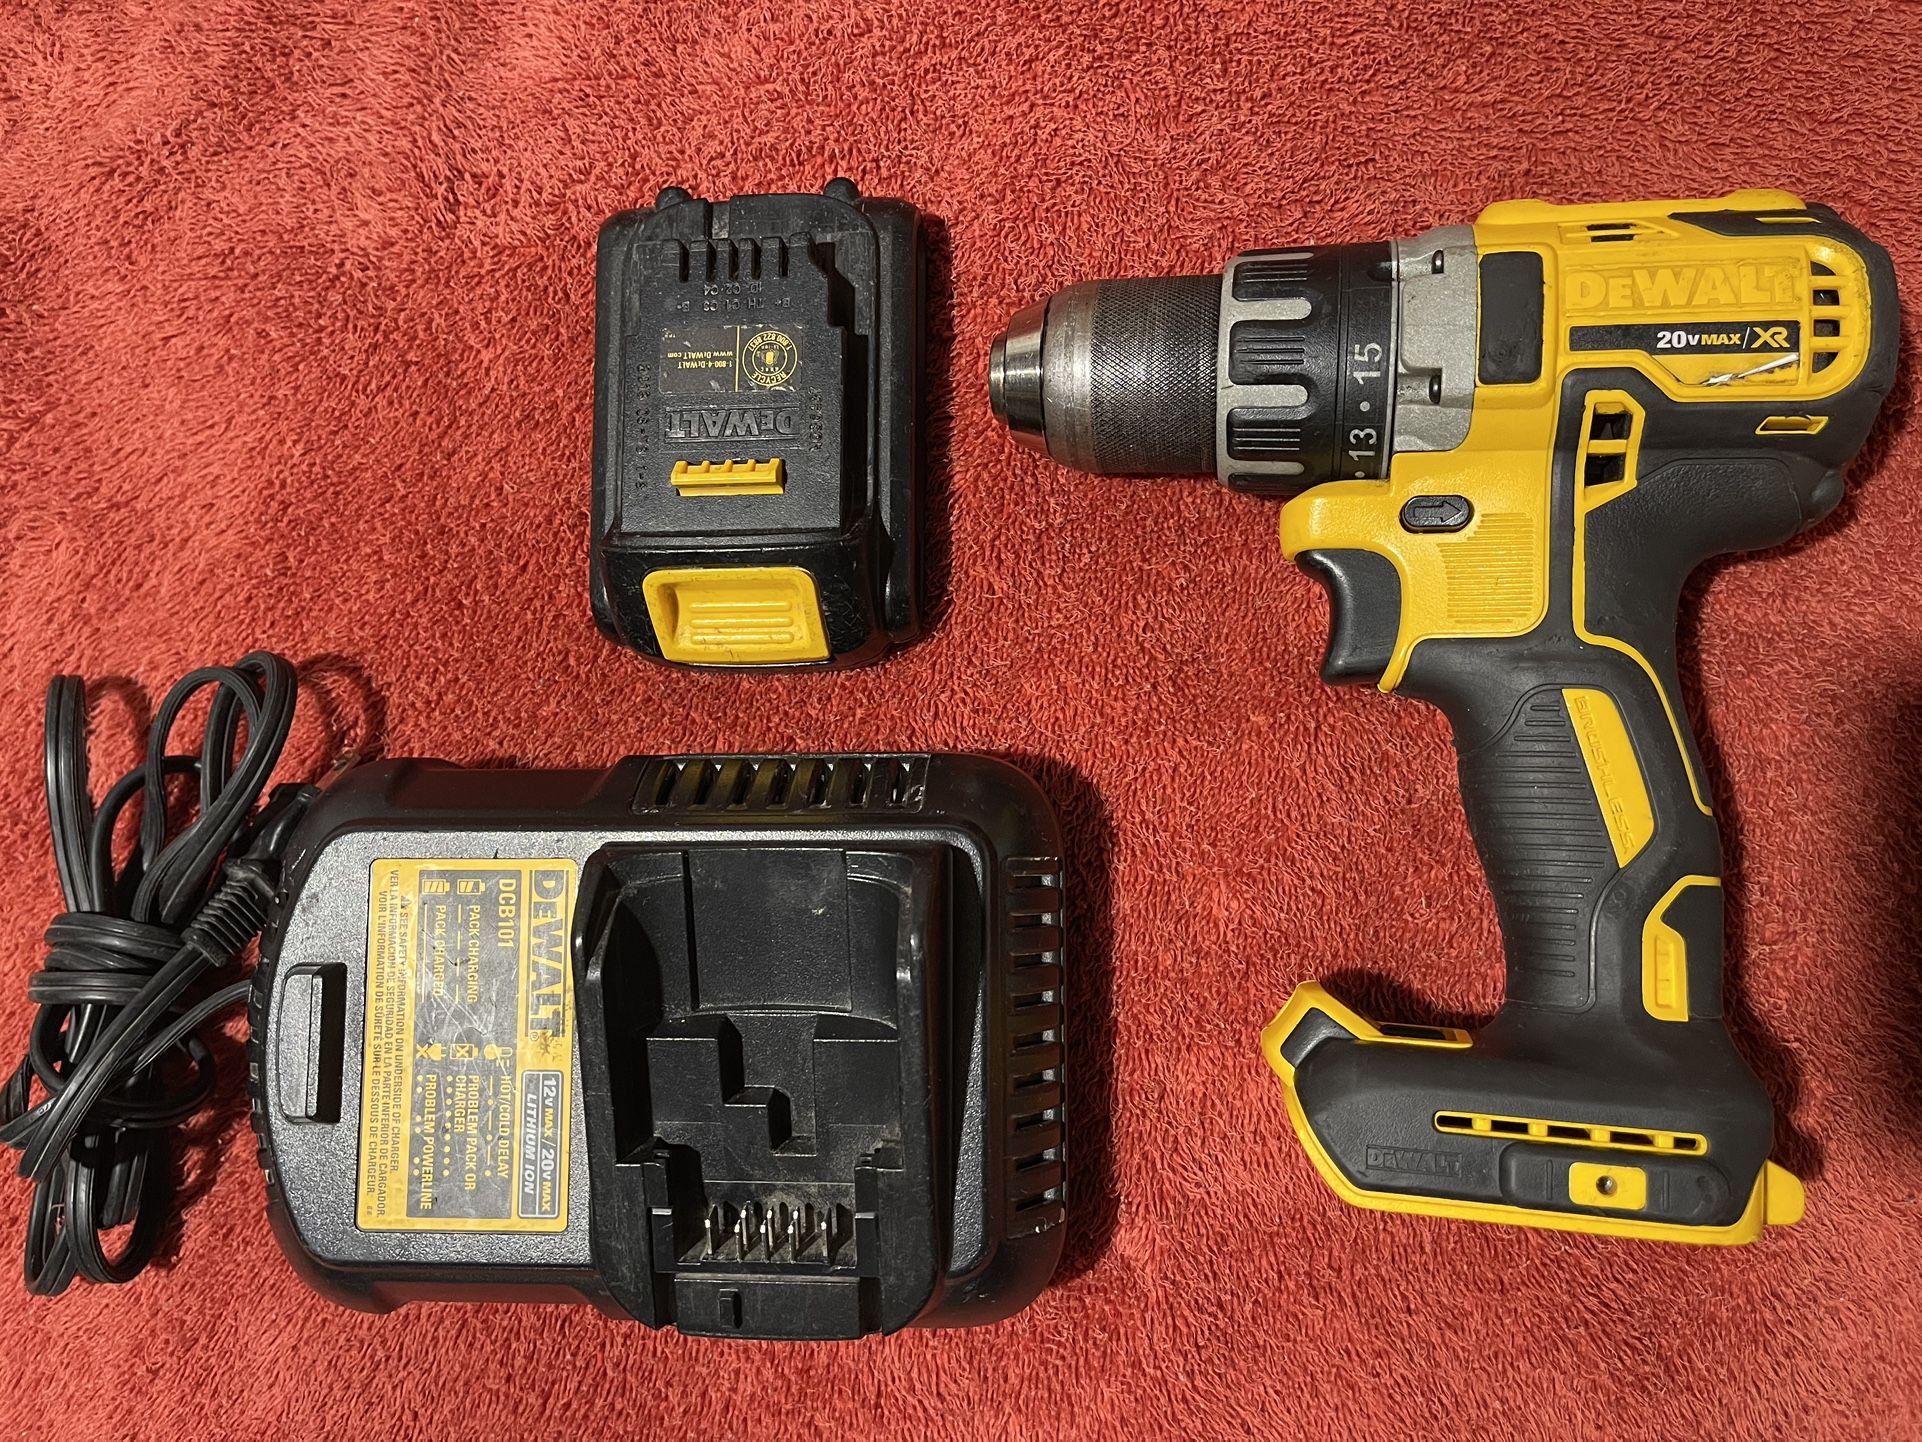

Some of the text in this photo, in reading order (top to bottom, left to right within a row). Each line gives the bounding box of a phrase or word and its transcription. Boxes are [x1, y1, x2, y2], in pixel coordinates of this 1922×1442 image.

[703, 282, 762, 296] ID C2 C4
[748, 298, 765, 309] TH
[703, 300, 718, 311] C3
[725, 299, 740, 310] C1
[1751, 326, 1790, 348] XR
[751, 371, 786, 383] RECYCLE
[1353, 342, 1382, 385] 15
[1348, 428, 1377, 461] 13
[1574, 696, 1636, 854] BRUSHLESS
[390, 870, 399, 887] VER
[378, 891, 387, 913] VOIR
[389, 889, 398, 901] LA
[400, 912, 409, 929] SEE
[497, 879, 516, 948] DCB101
[375, 915, 387, 990] L'INFORMATION
[398, 932, 408, 966] SAFETY
[432, 905, 446, 997] PACK CHARGED
[466, 905, 480, 1003] PACK CHARGING
[386, 972, 395, 984] DE
[375, 992, 384, 1004] DE
[384, 986, 395, 1039] SEGURIDAD
[396, 969, 407, 1037] INFORMATION
[373, 1005, 386, 1041] SÛRETÉ
[373, 1044, 382, 1062] SUR
[384, 1041, 392, 1055] EN
[395, 1039, 404, 1052] ON
[372, 1065, 381, 1076] LE
[383, 1057, 392, 1070] LA
[382, 1071, 391, 1100] PARTE
[393, 1055, 403, 1109] UNDERSIDE
[370, 1079, 381, 1124] DESSOUS
[454, 1075, 466, 1132] CHARGER
[380, 1102, 390, 1145] INFERIOR
[392, 1112, 401, 1124] OF
[464, 1075, 479, 1190] PROBLEM PACK OR
[498, 1075, 511, 1179] HOT/COLD DELAY
[544, 1108, 554, 1137] MAX
[370, 1127, 378, 1139] DE
[420, 1074, 436, 1210] PROBLEM POWERLINE
[524, 1094, 536, 1194] LITHIUM ION
[379, 1149, 388, 1161] DE
[376, 1163, 387, 1218] CARGADOR.
[542, 1181, 552, 1211] MAX
